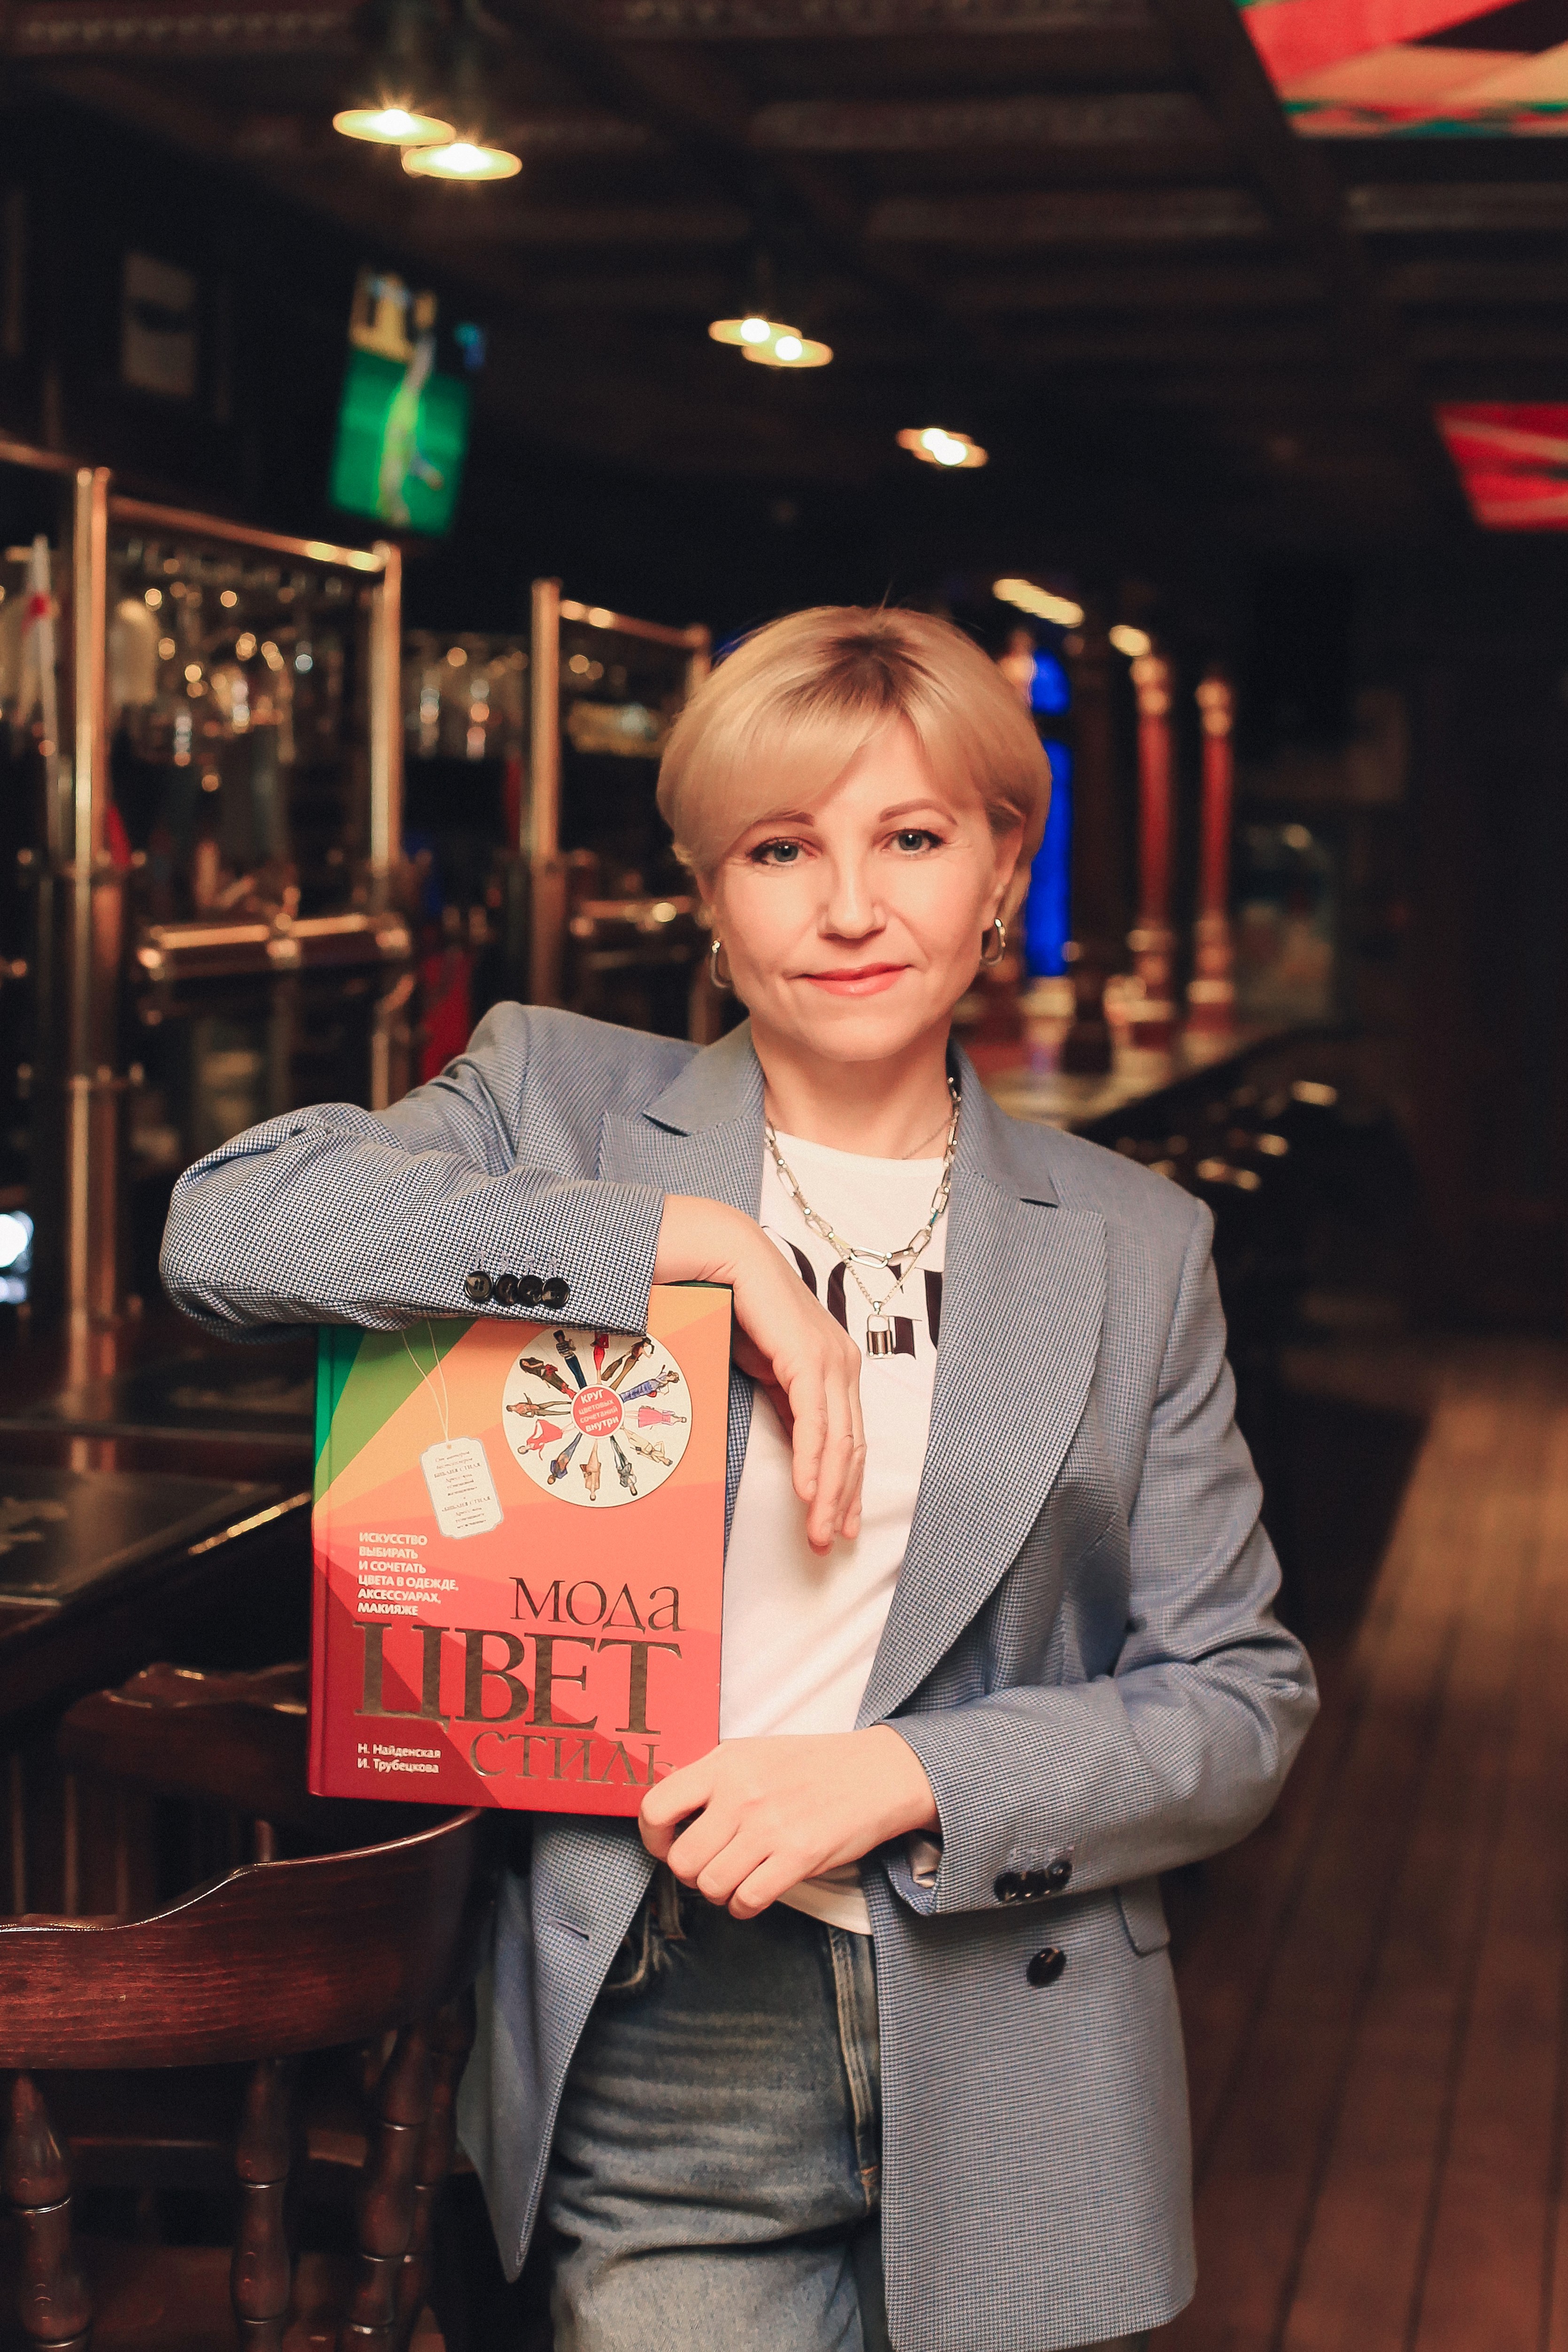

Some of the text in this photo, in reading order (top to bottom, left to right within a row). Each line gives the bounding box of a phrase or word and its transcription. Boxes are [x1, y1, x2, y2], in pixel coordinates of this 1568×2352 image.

[580, 1389, 604, 1404] КРУГ
[585, 1416, 619, 1432] внутри
[359, 1532, 428, 1546] ИСКУССТВО
[358, 1546, 419, 1559] ВЫБИРАТЬ
[358, 1560, 427, 1573] И СОЧЕТАТЬ
[358, 1574, 459, 1591] ЦВЕТА В ОДЕЖДЕ,
[357, 1588, 442, 1604] АКСЕССУАРАХ,
[357, 1602, 419, 1616] МАКИЯЖЕ
[353, 1620, 683, 1736] ЦВЕТ
[357, 1743, 442, 1759] Н. Найденская
[357, 1758, 439, 1773] И. Трубецкова
